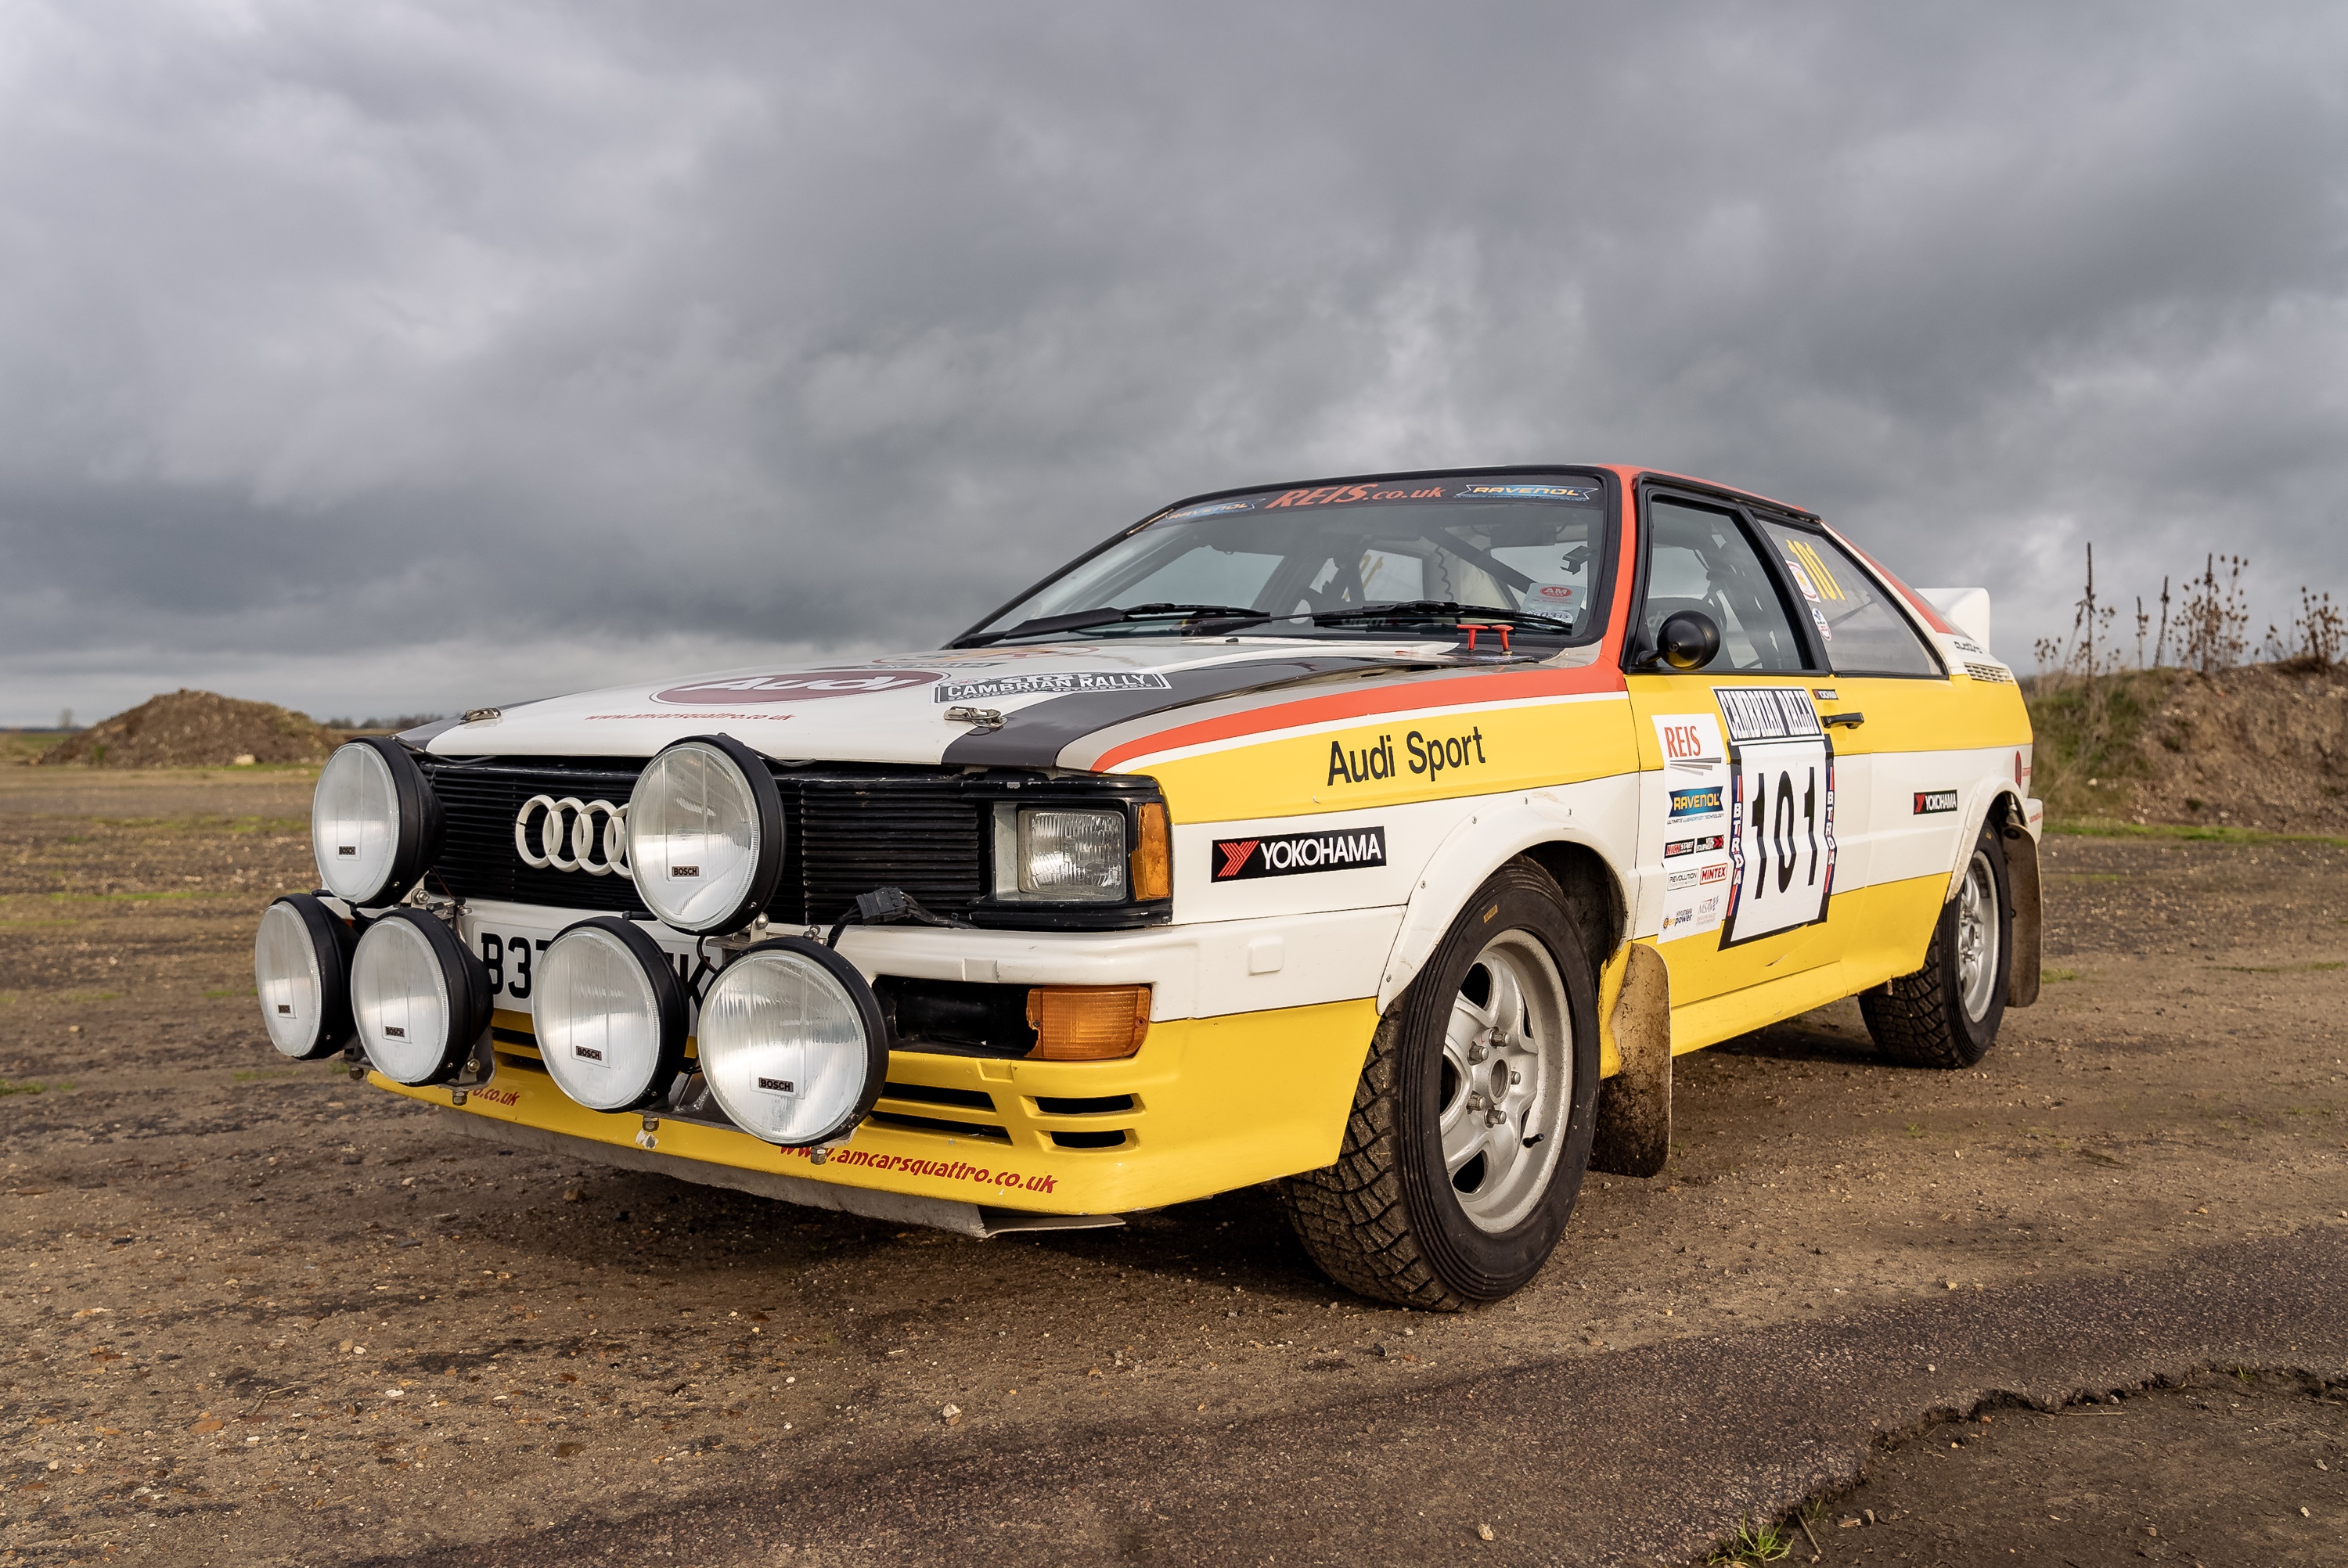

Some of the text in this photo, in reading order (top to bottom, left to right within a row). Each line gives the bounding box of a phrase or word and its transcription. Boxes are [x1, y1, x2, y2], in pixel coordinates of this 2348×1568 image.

[1264, 483, 1446, 509] REIS.co.uk
[1473, 486, 1580, 496] RAVENOL
[1785, 538, 1846, 601] 101
[673, 676, 920, 692] Audi
[947, 679, 1073, 697] CAMBRIAN
[1079, 674, 1146, 688] RALLY
[1717, 690, 1820, 739] CAMBRIAN RALLY
[1664, 725, 1702, 757] REIS
[1327, 726, 1486, 786] Audi Sport
[1673, 793, 1720, 811] RAVENOL
[1925, 793, 1957, 811] YOKOHAMA
[1752, 766, 1818, 900] 101
[1826, 791, 1836, 865] BTRDA
[1260, 833, 1382, 870] YOKOHAMA
[1731, 802, 1744, 886] BTRDA
[674, 867, 697, 876] BOSCH
[1669, 872, 1697, 883] REVOLUTION
[1702, 866, 1727, 881] MINTEX
[387, 1027, 404, 1038] BOSCH
[577, 1047, 600, 1059] BOSCH
[760, 1080, 790, 1091] BOSCH
